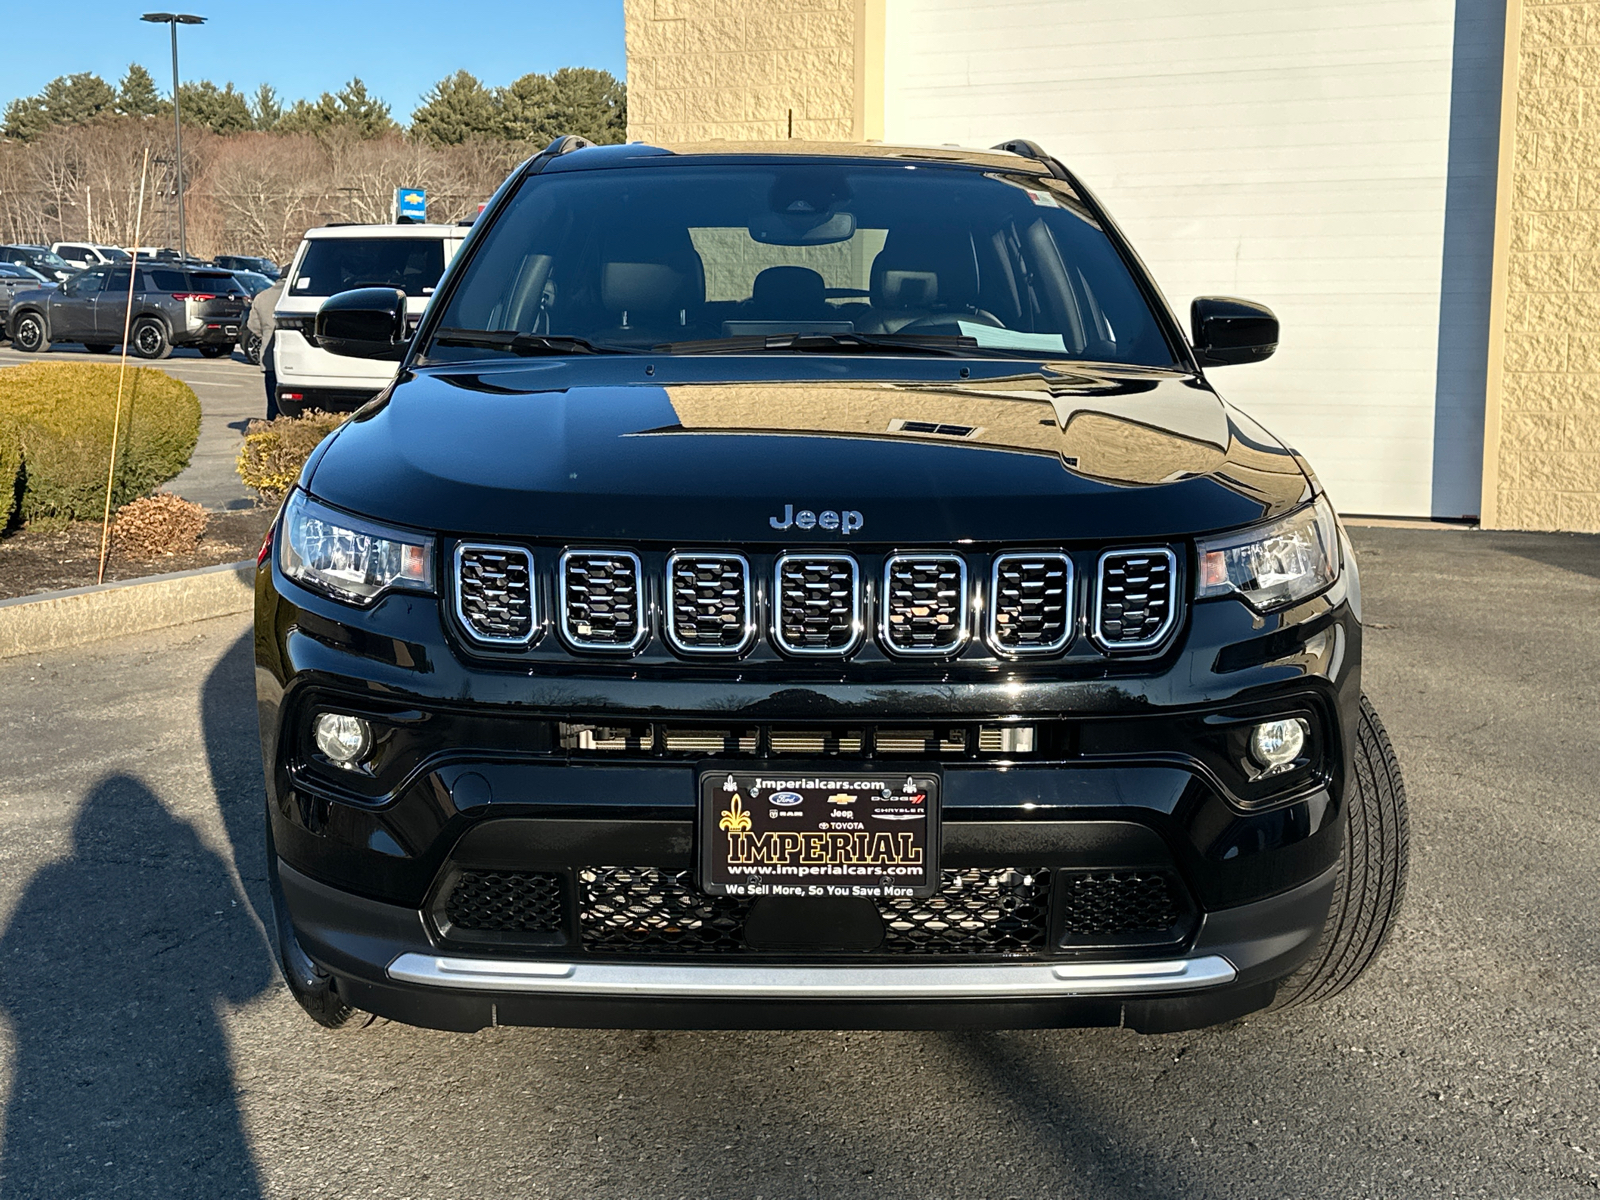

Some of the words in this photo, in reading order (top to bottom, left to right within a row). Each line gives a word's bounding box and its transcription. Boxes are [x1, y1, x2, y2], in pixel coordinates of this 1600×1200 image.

[769, 504, 864, 534] Jeep
[755, 778, 885, 791] Imperialcars.com
[830, 809, 853, 819] Jeep
[830, 822, 864, 830] TOYOTA
[728, 832, 923, 864] IMPERIAL
[727, 865, 923, 877] www.imperialcars.com
[725, 884, 745, 894] We
[747, 884, 769, 895] Sell
[772, 885, 806, 897] More,
[808, 886, 824, 895] So
[827, 886, 849, 895] You
[852, 886, 881, 896] Save
[884, 886, 914, 896] More
